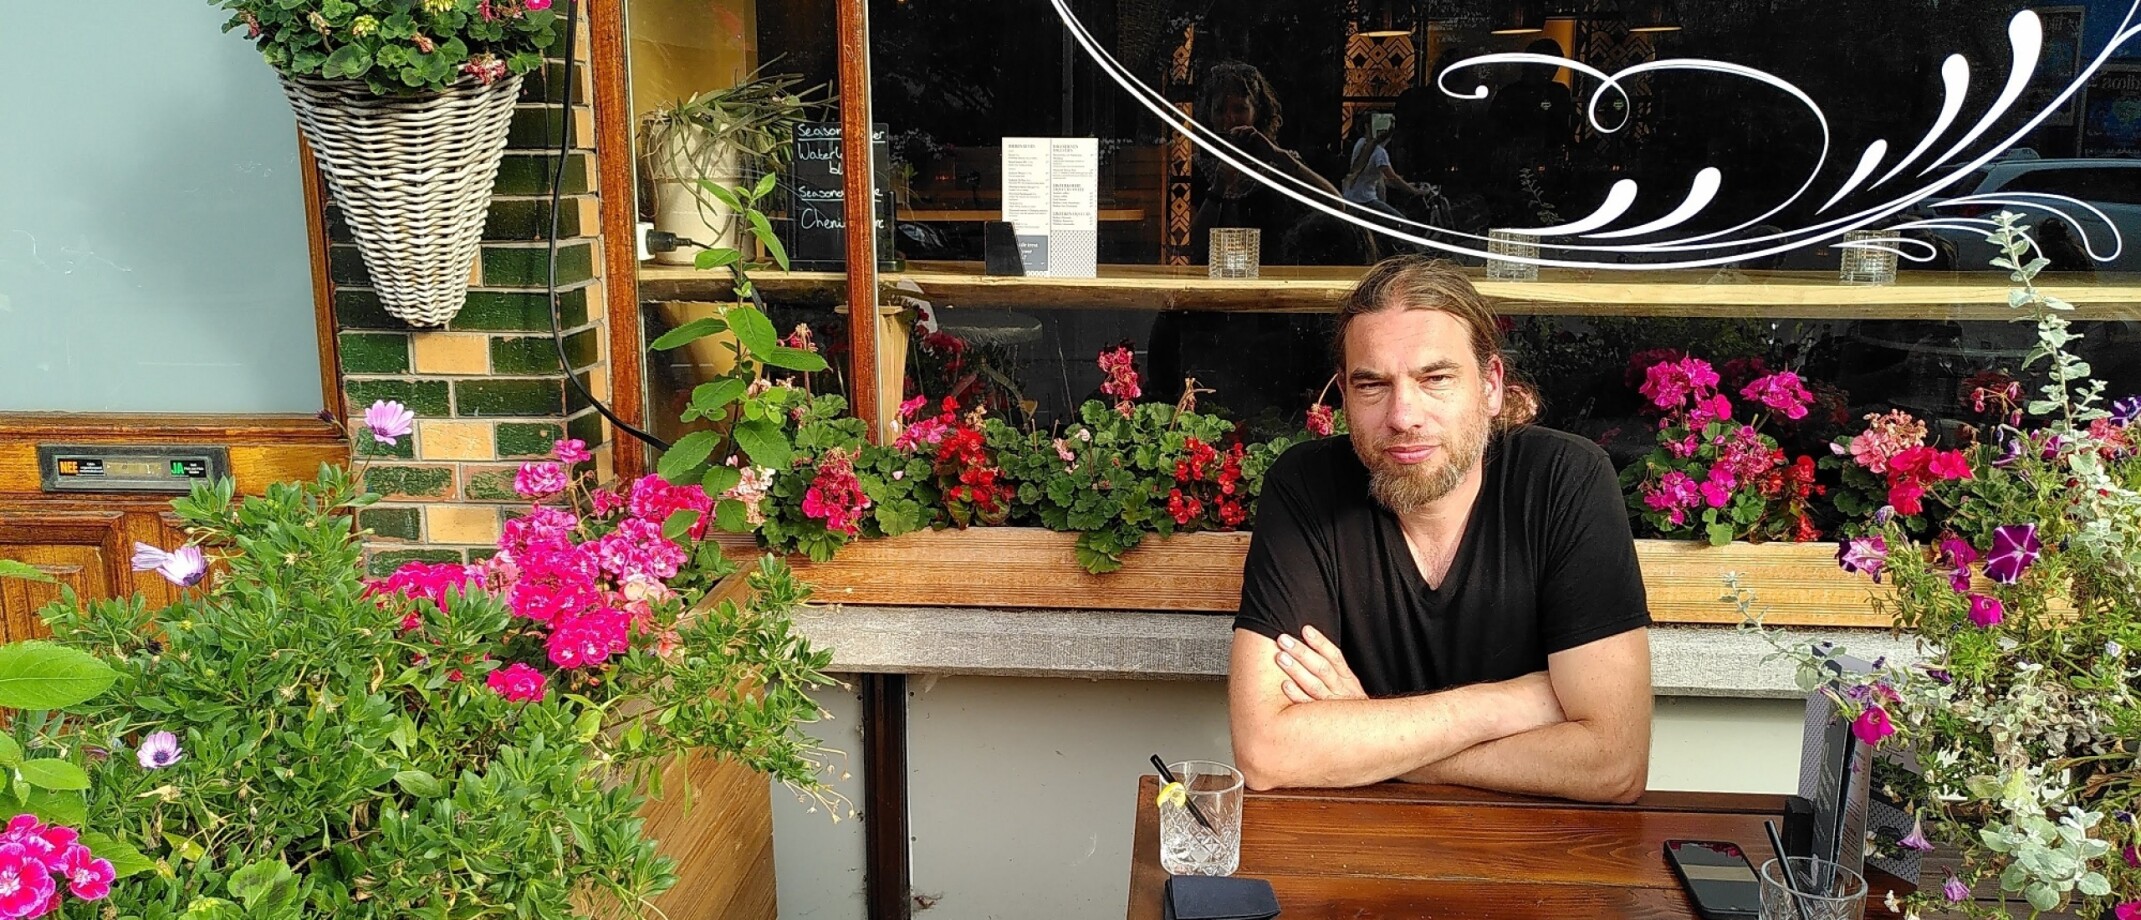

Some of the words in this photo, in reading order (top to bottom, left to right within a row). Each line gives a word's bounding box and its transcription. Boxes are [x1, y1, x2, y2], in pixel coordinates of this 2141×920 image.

[797, 123, 842, 137] Season
[798, 185, 845, 198] Seasona
[801, 208, 846, 229] Cheni
[59, 461, 78, 473] NEE
[171, 462, 184, 474] JA
